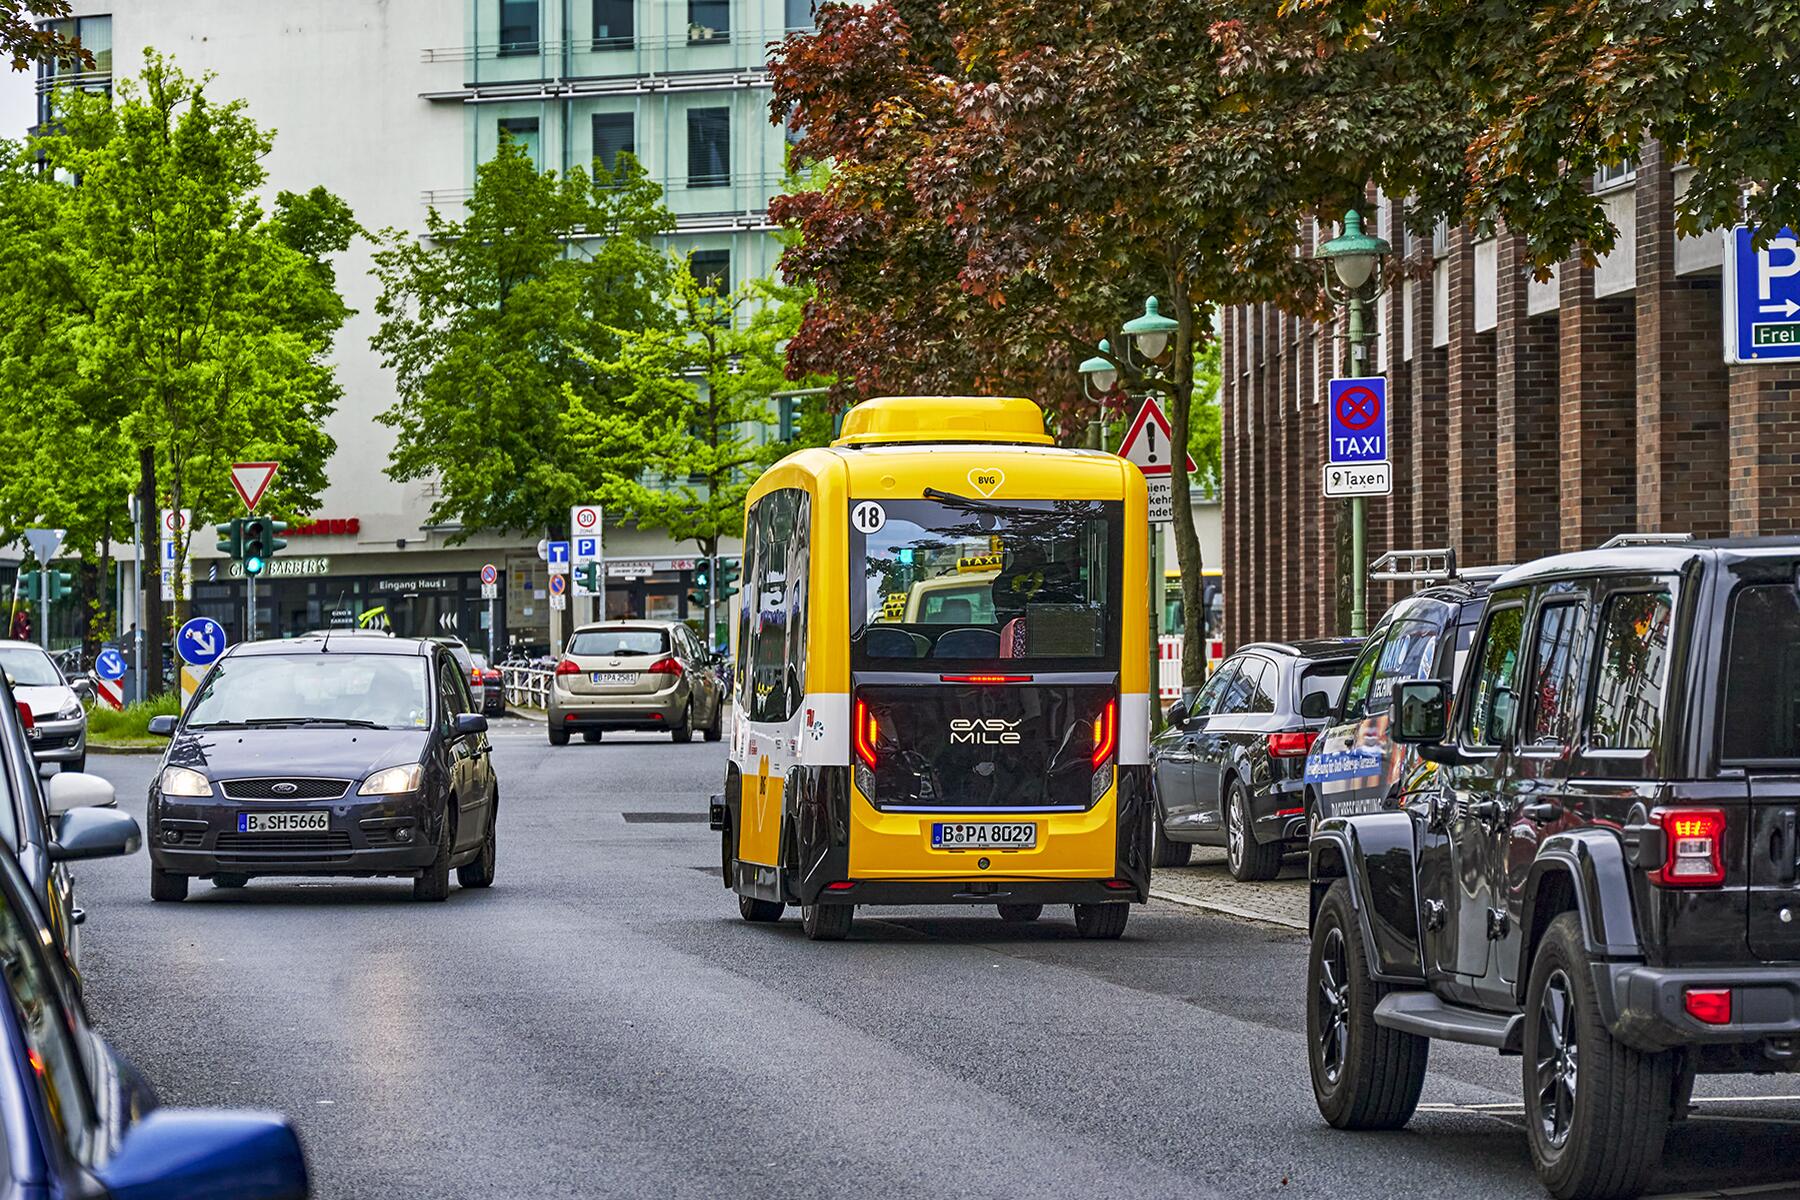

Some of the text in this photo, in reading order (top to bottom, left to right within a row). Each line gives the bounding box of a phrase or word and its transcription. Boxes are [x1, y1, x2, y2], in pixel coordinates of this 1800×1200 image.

[1758, 237, 1800, 300] P
[1759, 327, 1795, 343] Frei
[1335, 436, 1380, 455] TAXI
[978, 476, 995, 485] BVG
[1332, 471, 1384, 486] 9 Taxen
[1148, 483, 1170, 492] ien-
[1149, 495, 1172, 505] kehr
[580, 513, 592, 523] 30
[857, 506, 880, 529] 18
[1149, 507, 1172, 517] ndet
[582, 541, 591, 555] P
[268, 557, 329, 577] BARBER'S
[966, 556, 1000, 566] TAXI
[379, 580, 416, 591] Eingang
[418, 579, 440, 589] Haus
[943, 826, 954, 842] B
[991, 826, 1033, 842] 8029
